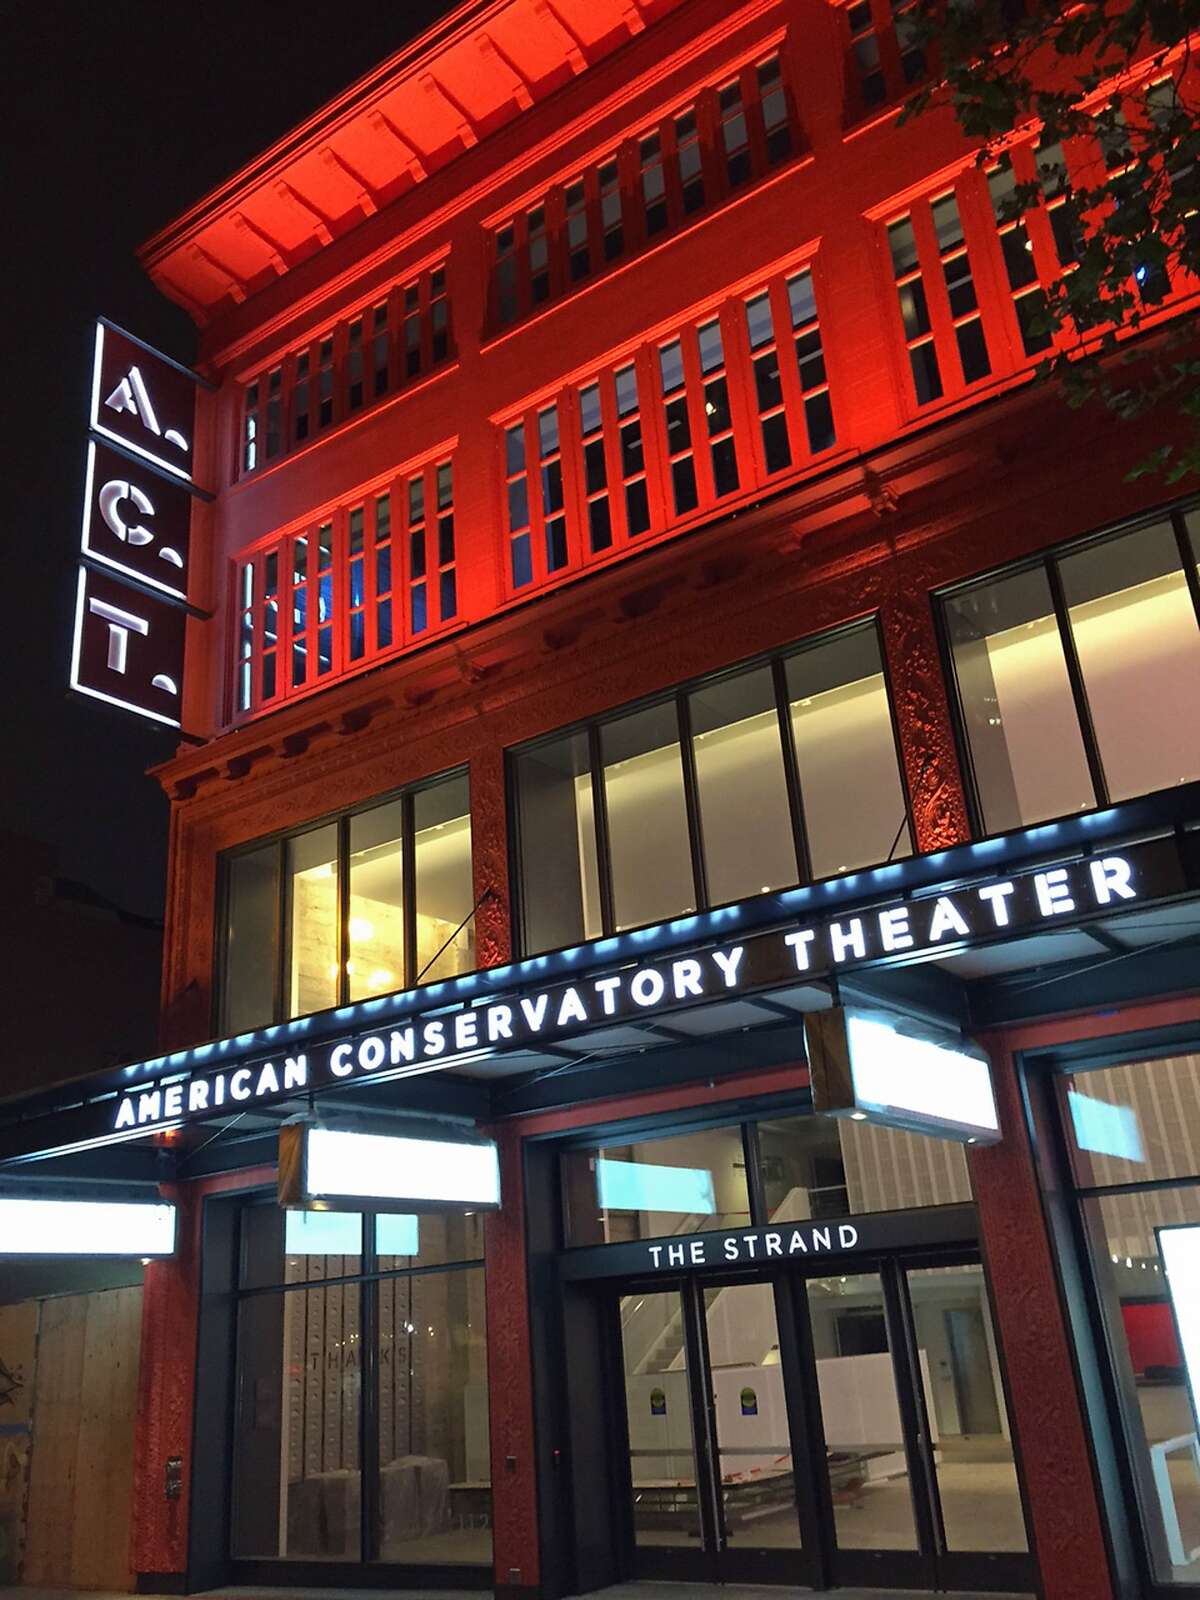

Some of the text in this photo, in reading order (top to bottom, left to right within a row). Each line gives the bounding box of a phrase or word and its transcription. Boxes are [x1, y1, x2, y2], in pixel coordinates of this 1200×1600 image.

[114, 856, 1137, 1129] AMERICAN CONSERVATORY THEATER
[648, 1224, 859, 1268] THE STRAND
[310, 1347, 407, 1370] THAKS
